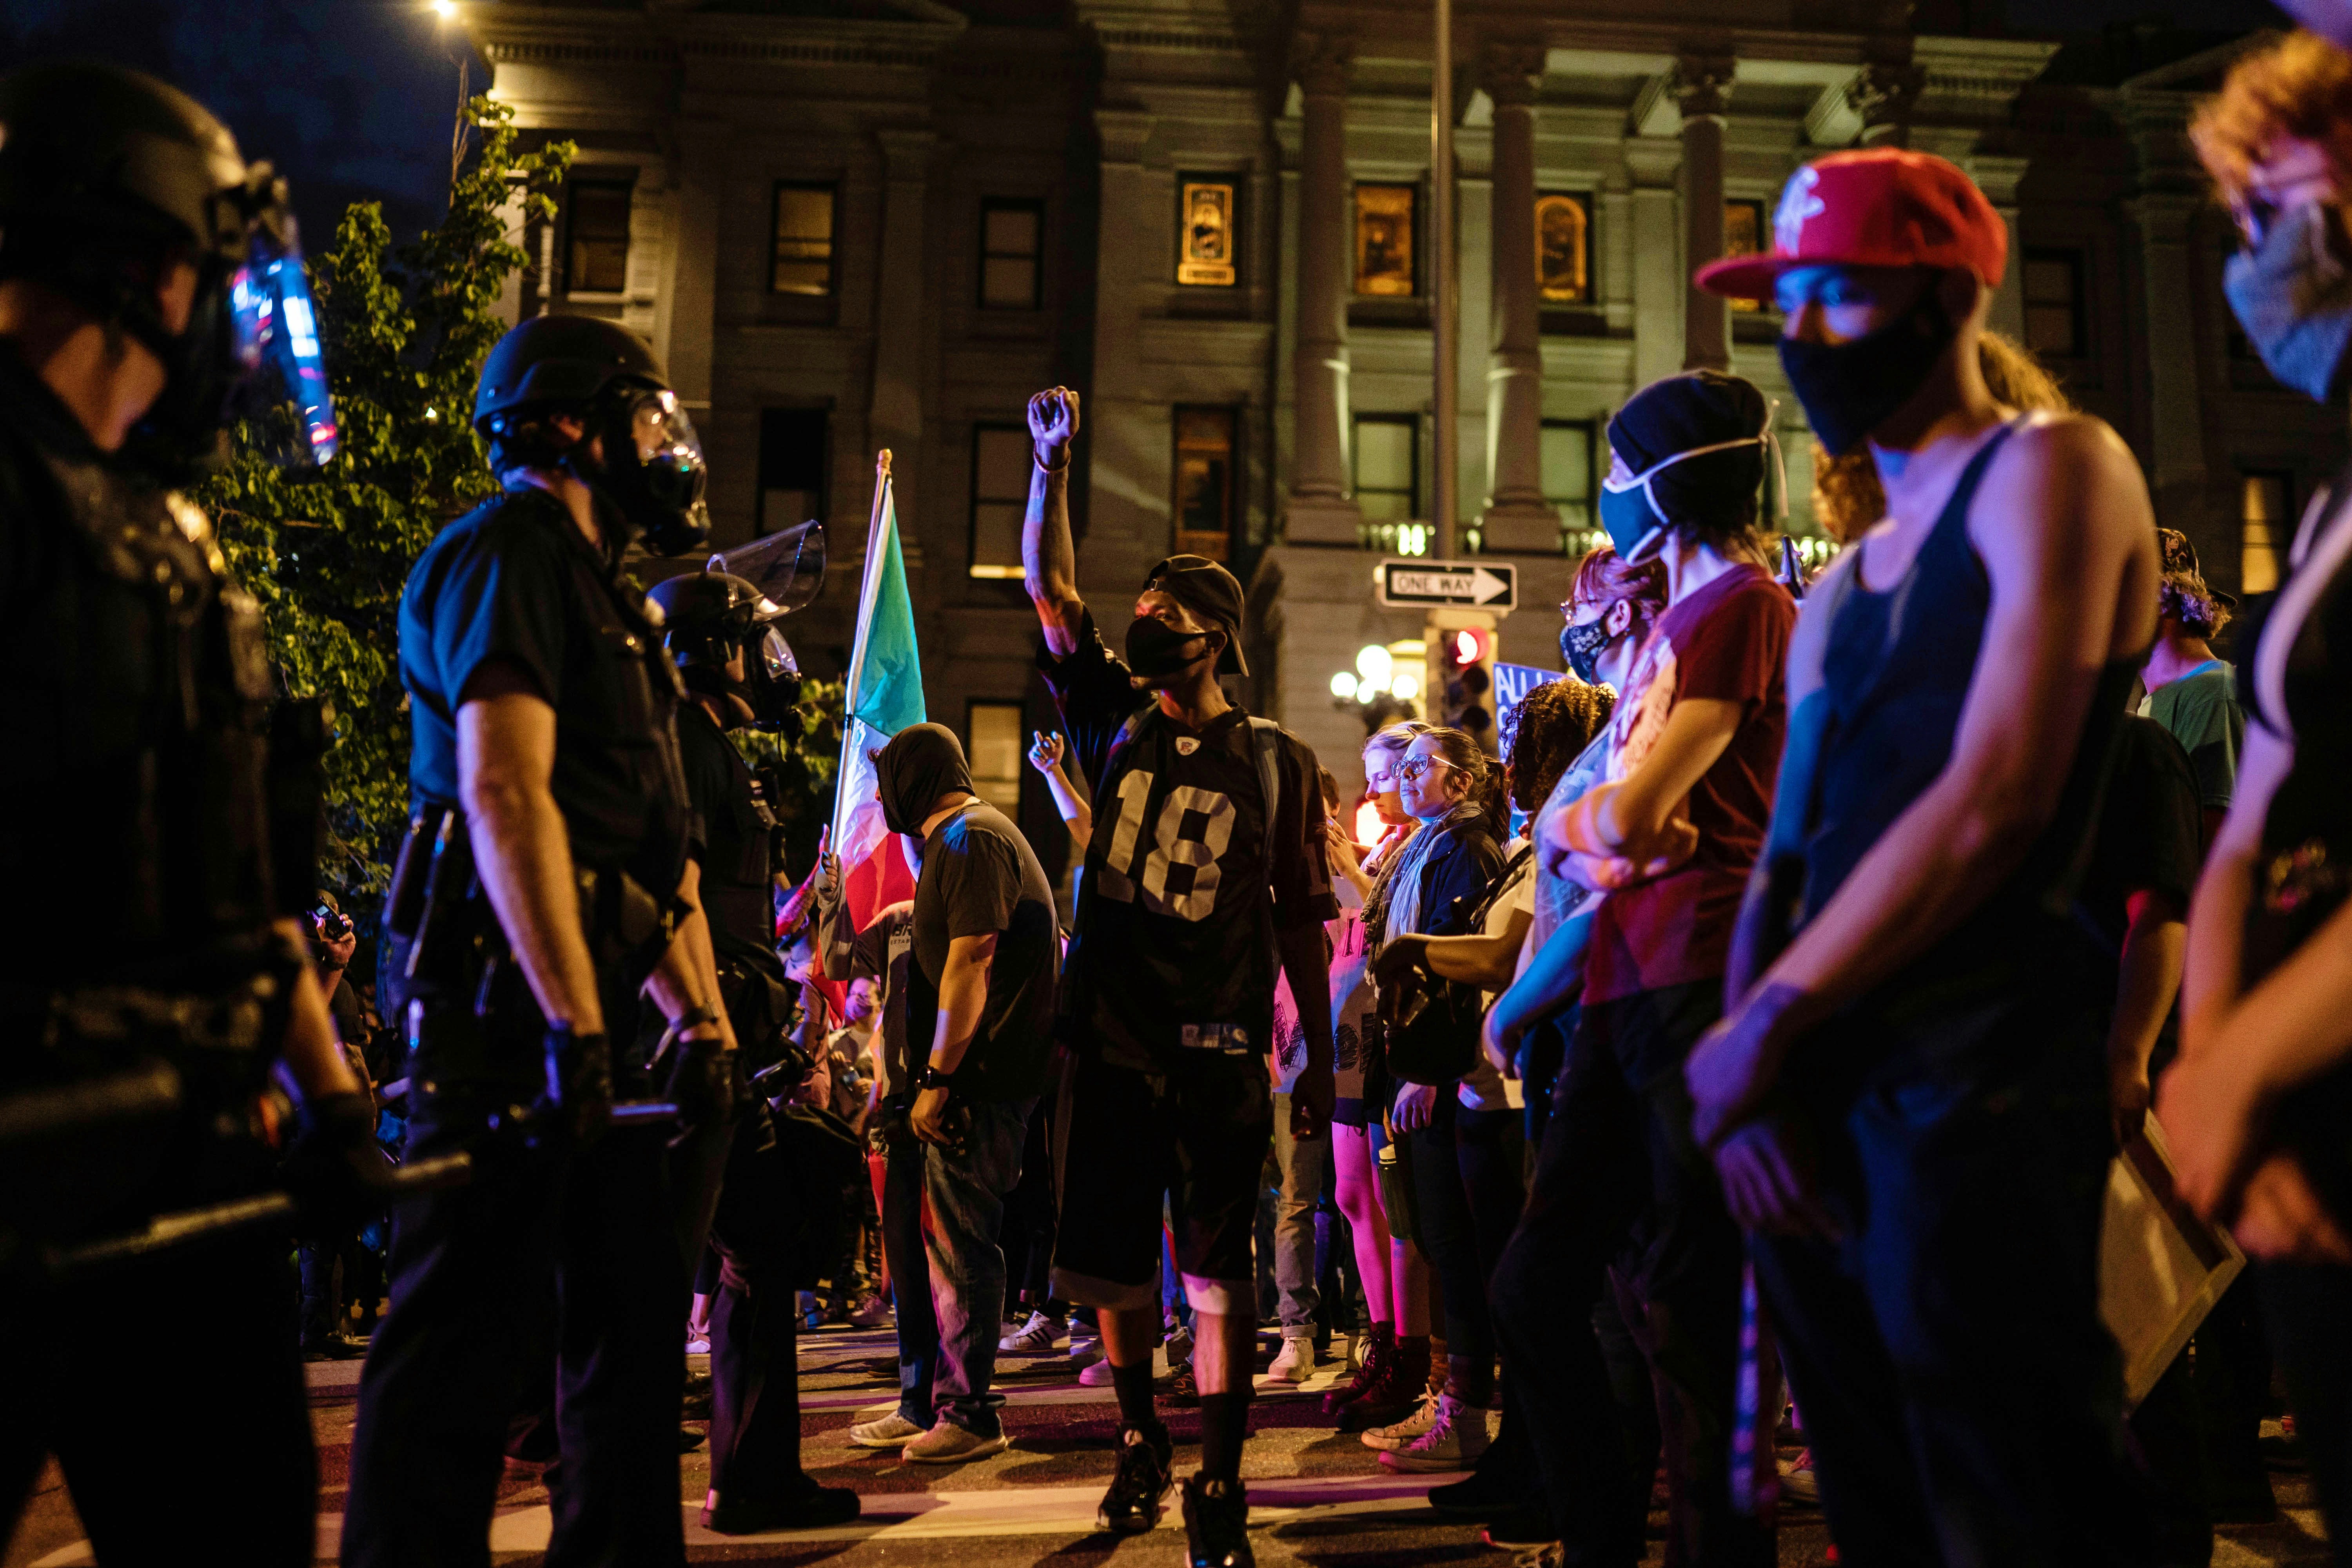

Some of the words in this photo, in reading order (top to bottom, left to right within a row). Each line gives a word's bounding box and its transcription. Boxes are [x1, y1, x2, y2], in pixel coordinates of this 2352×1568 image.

[1398, 576, 1429, 593] ONE
[1440, 577, 1474, 592] WAY
[1097, 769, 1236, 922] 18
